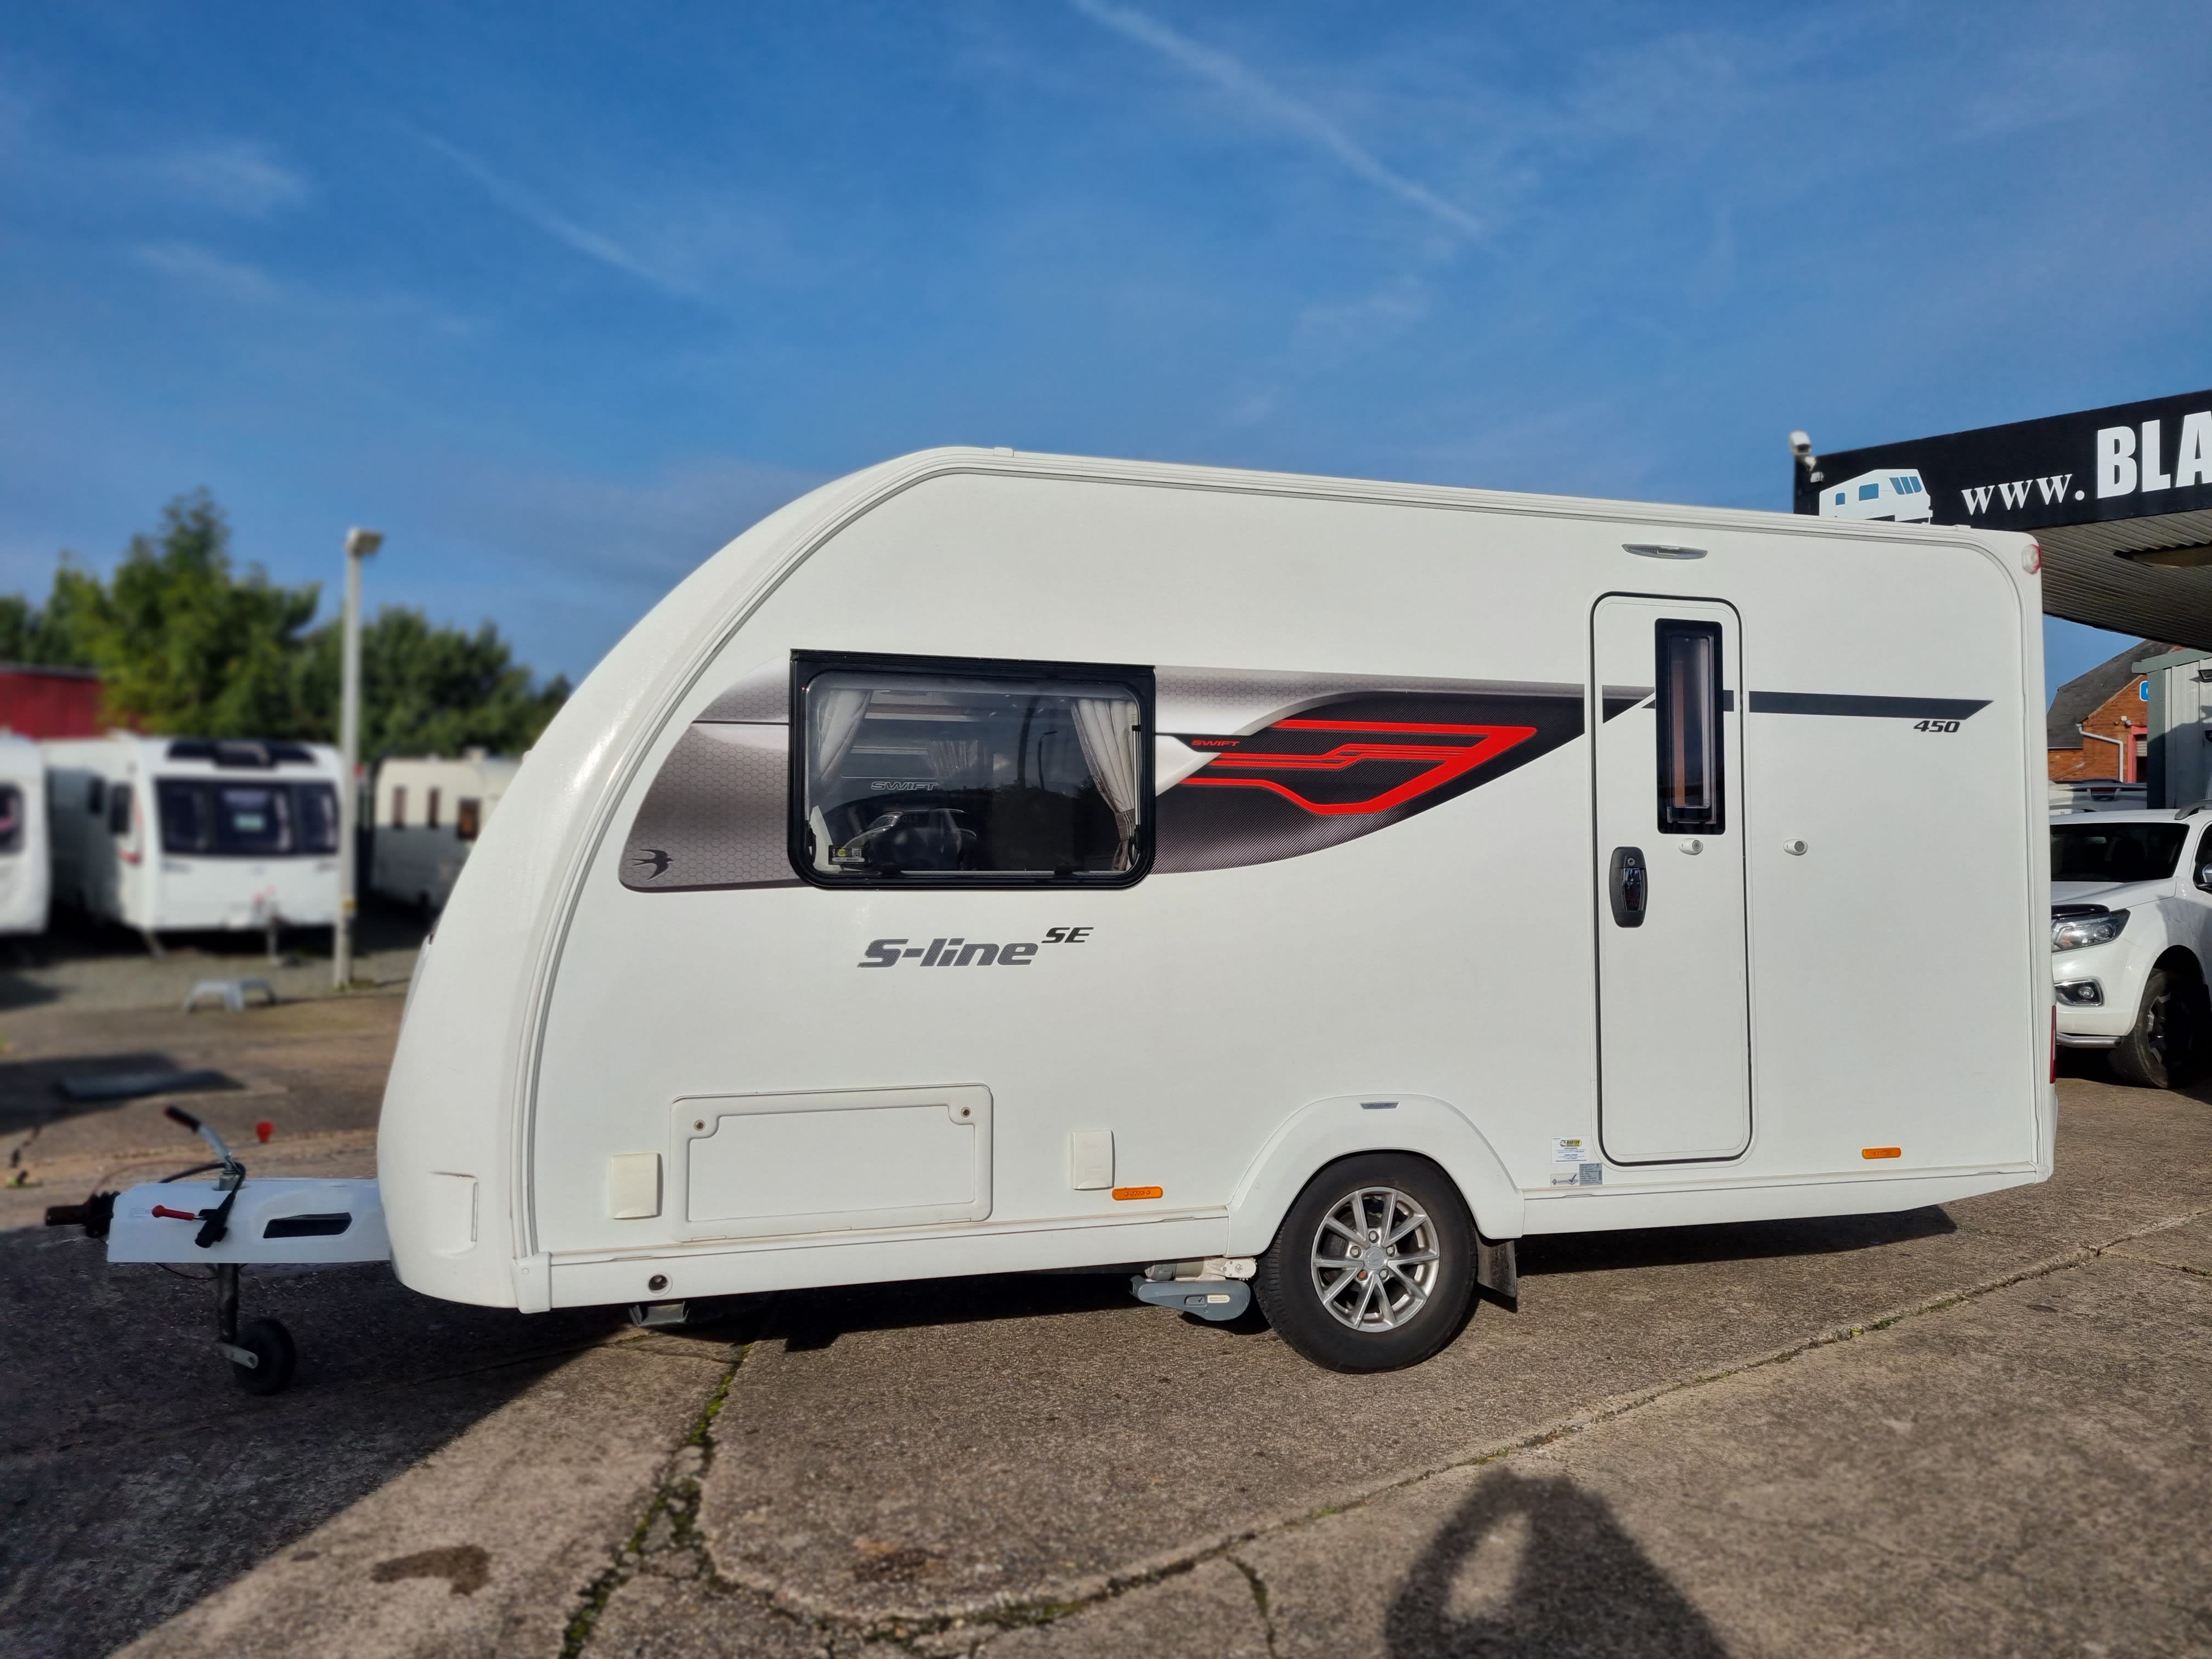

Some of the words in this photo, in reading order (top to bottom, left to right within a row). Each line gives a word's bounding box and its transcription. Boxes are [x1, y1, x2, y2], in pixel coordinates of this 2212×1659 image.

[1914, 720, 1960, 732] 450
[871, 781, 939, 791] SWIFT
[857, 938, 1039, 968] S-line
[1041, 927, 1094, 943] SE
